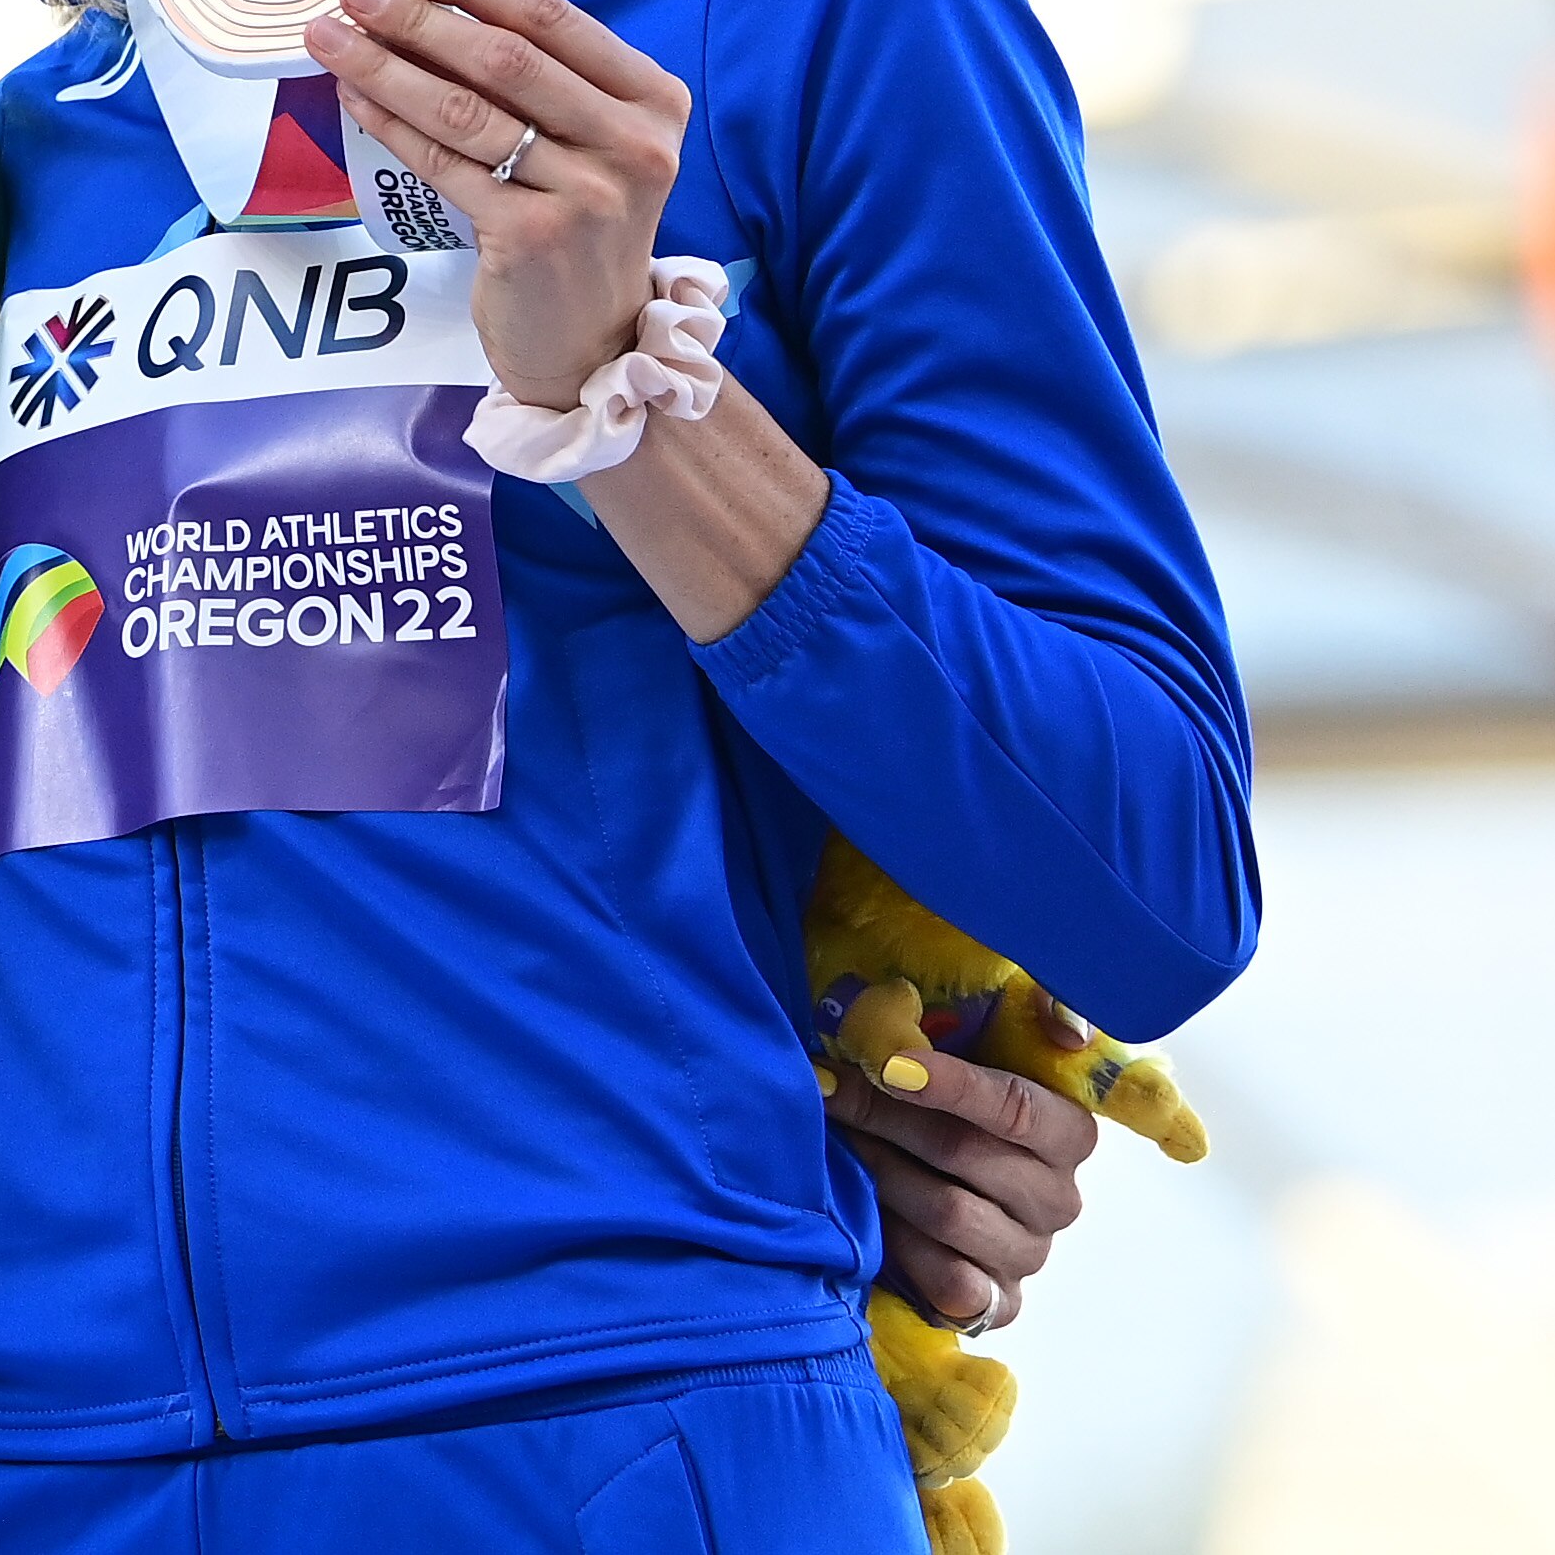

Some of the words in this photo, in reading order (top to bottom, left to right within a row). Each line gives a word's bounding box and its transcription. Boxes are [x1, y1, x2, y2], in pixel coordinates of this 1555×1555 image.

[137, 255, 409, 378] QNB
[126, 520, 251, 563] WORLD
[260, 505, 463, 550] ATHLETICS
[124, 542, 468, 603] CHAMPIONSHIPS
